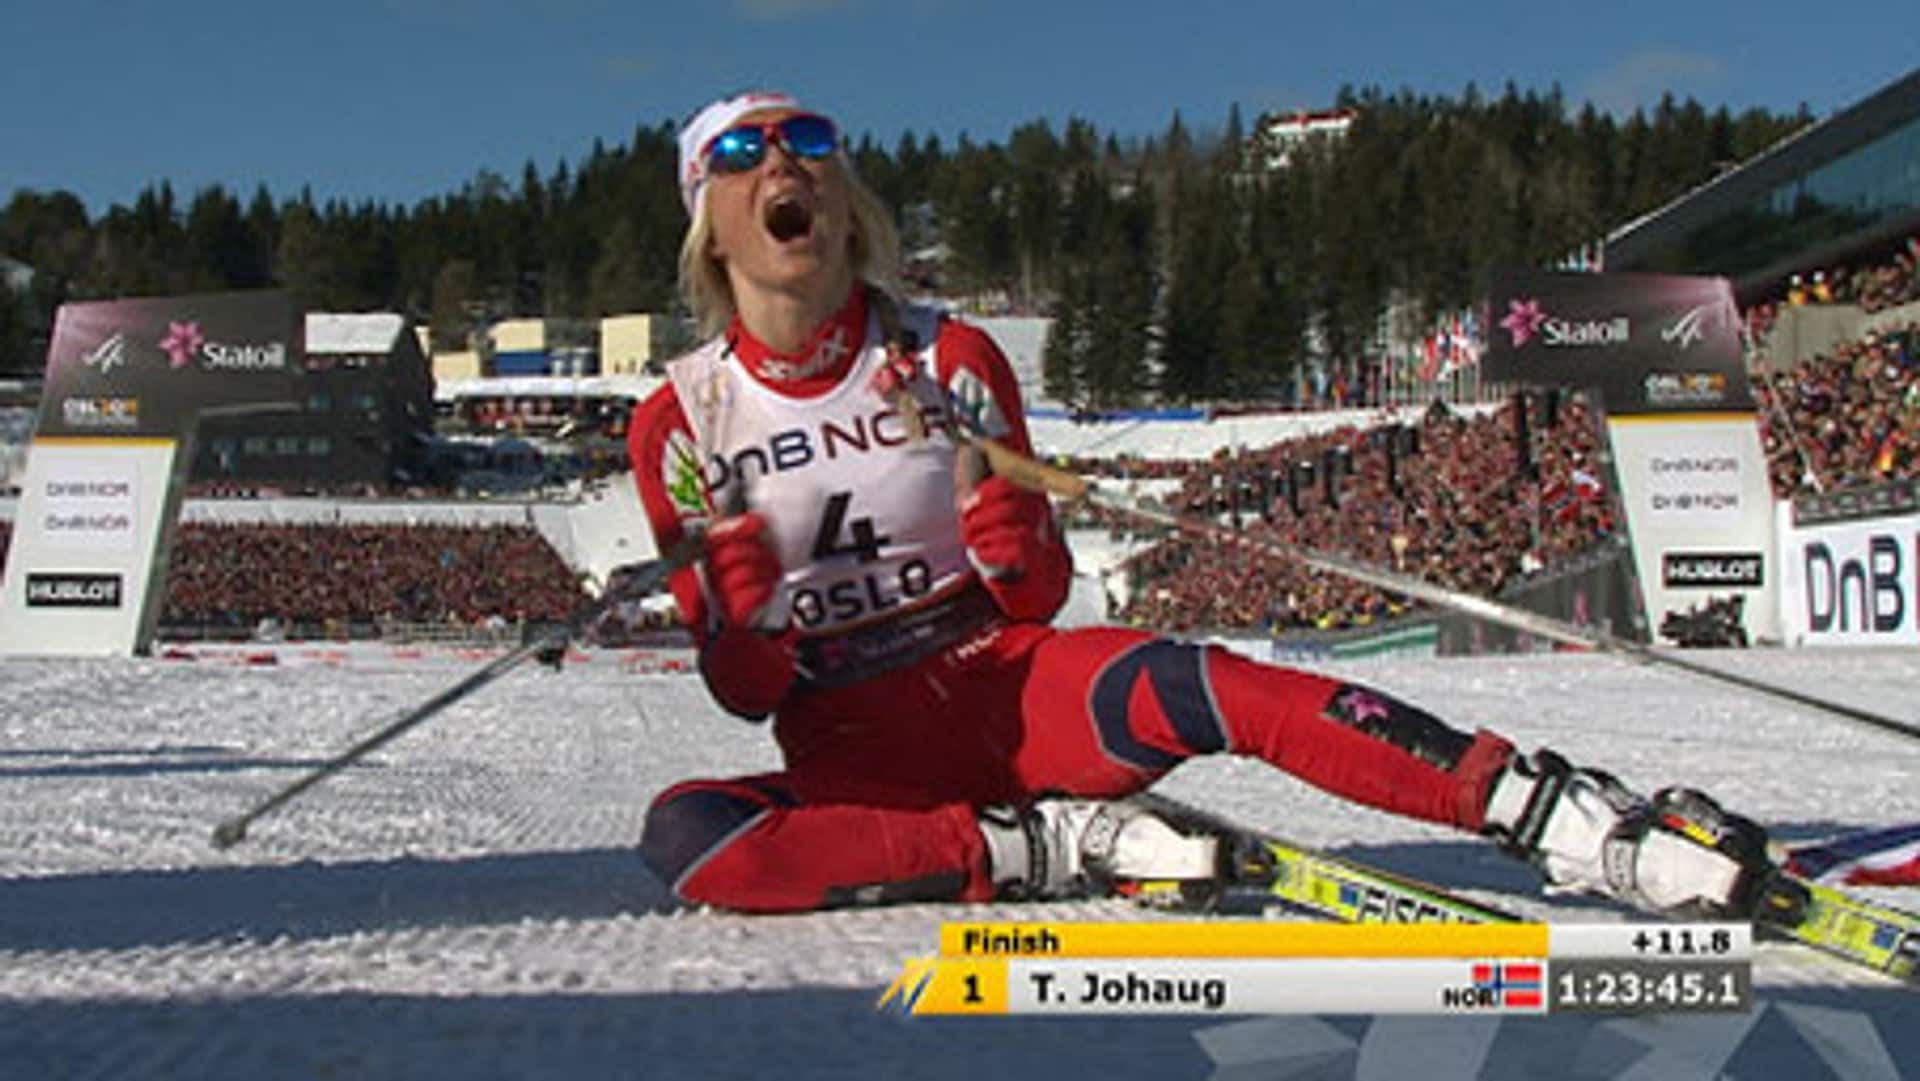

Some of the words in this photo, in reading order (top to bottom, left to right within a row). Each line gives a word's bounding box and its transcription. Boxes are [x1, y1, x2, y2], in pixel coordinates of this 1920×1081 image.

[1543, 317, 1630, 345] Statoil
[202, 341, 286, 369] Statoil
[813, 491, 891, 564] 4
[1668, 559, 1757, 578] HUBLOT
[29, 581, 117, 600] HUBLOT
[792, 559, 931, 628] OSLO
[1805, 534, 1905, 633] DnB
